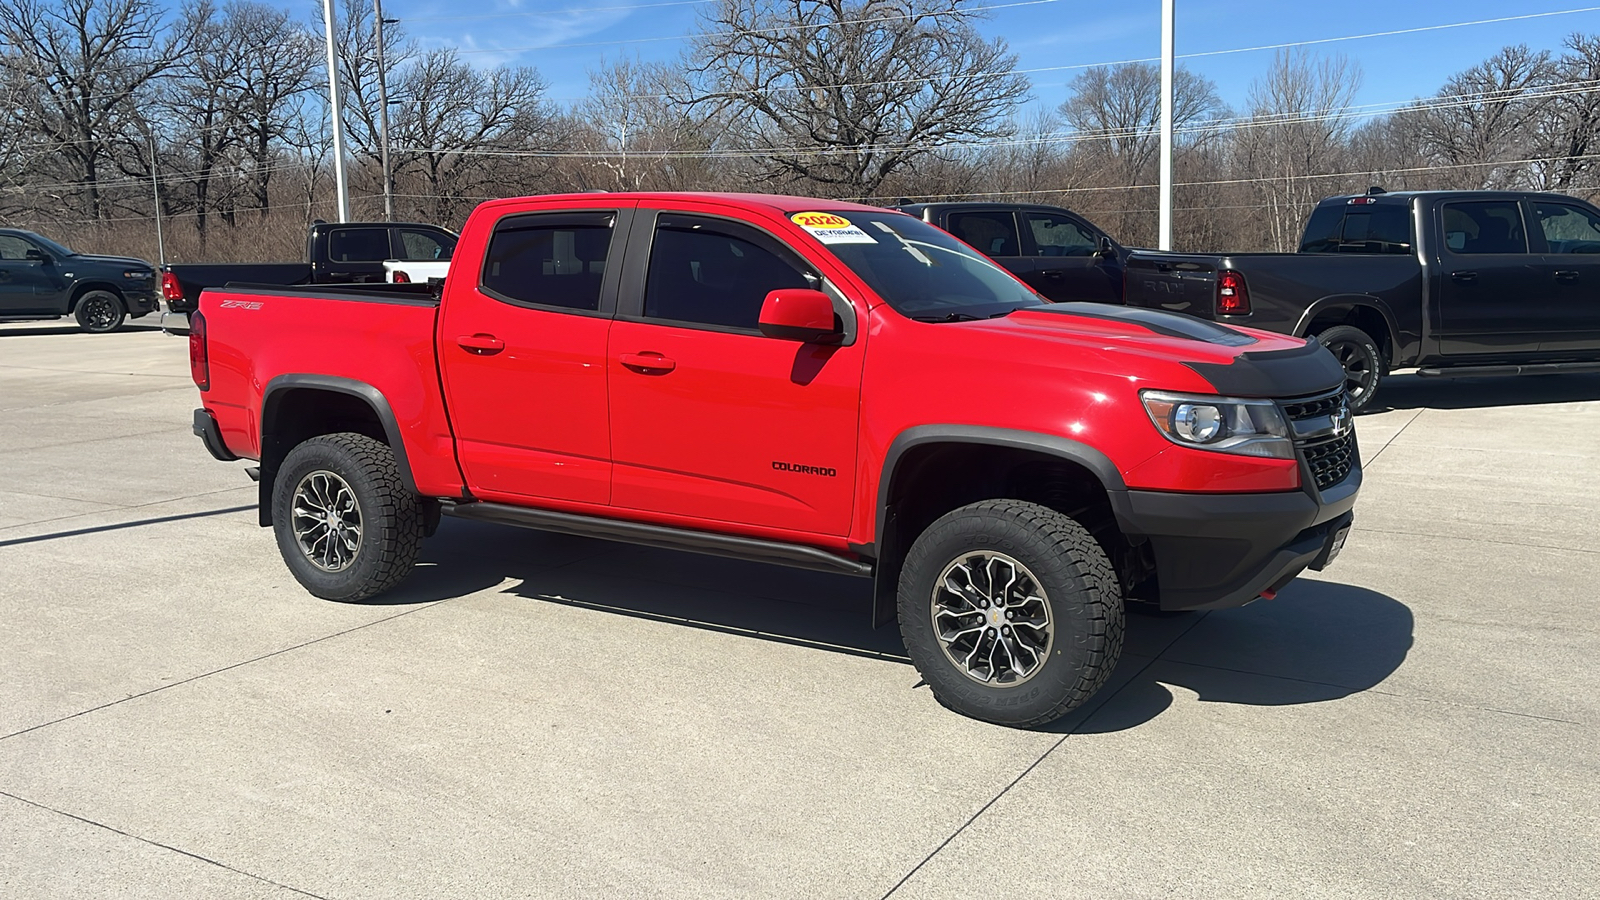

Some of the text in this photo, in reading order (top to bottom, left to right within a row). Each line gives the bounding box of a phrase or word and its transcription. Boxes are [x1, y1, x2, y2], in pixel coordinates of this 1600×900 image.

[798, 215, 845, 226] 2020
[1143, 280, 1185, 294] RAM
[220, 299, 264, 310] ZR2
[772, 461, 837, 477] COLORADO
[964, 532, 1015, 550] TOYO
